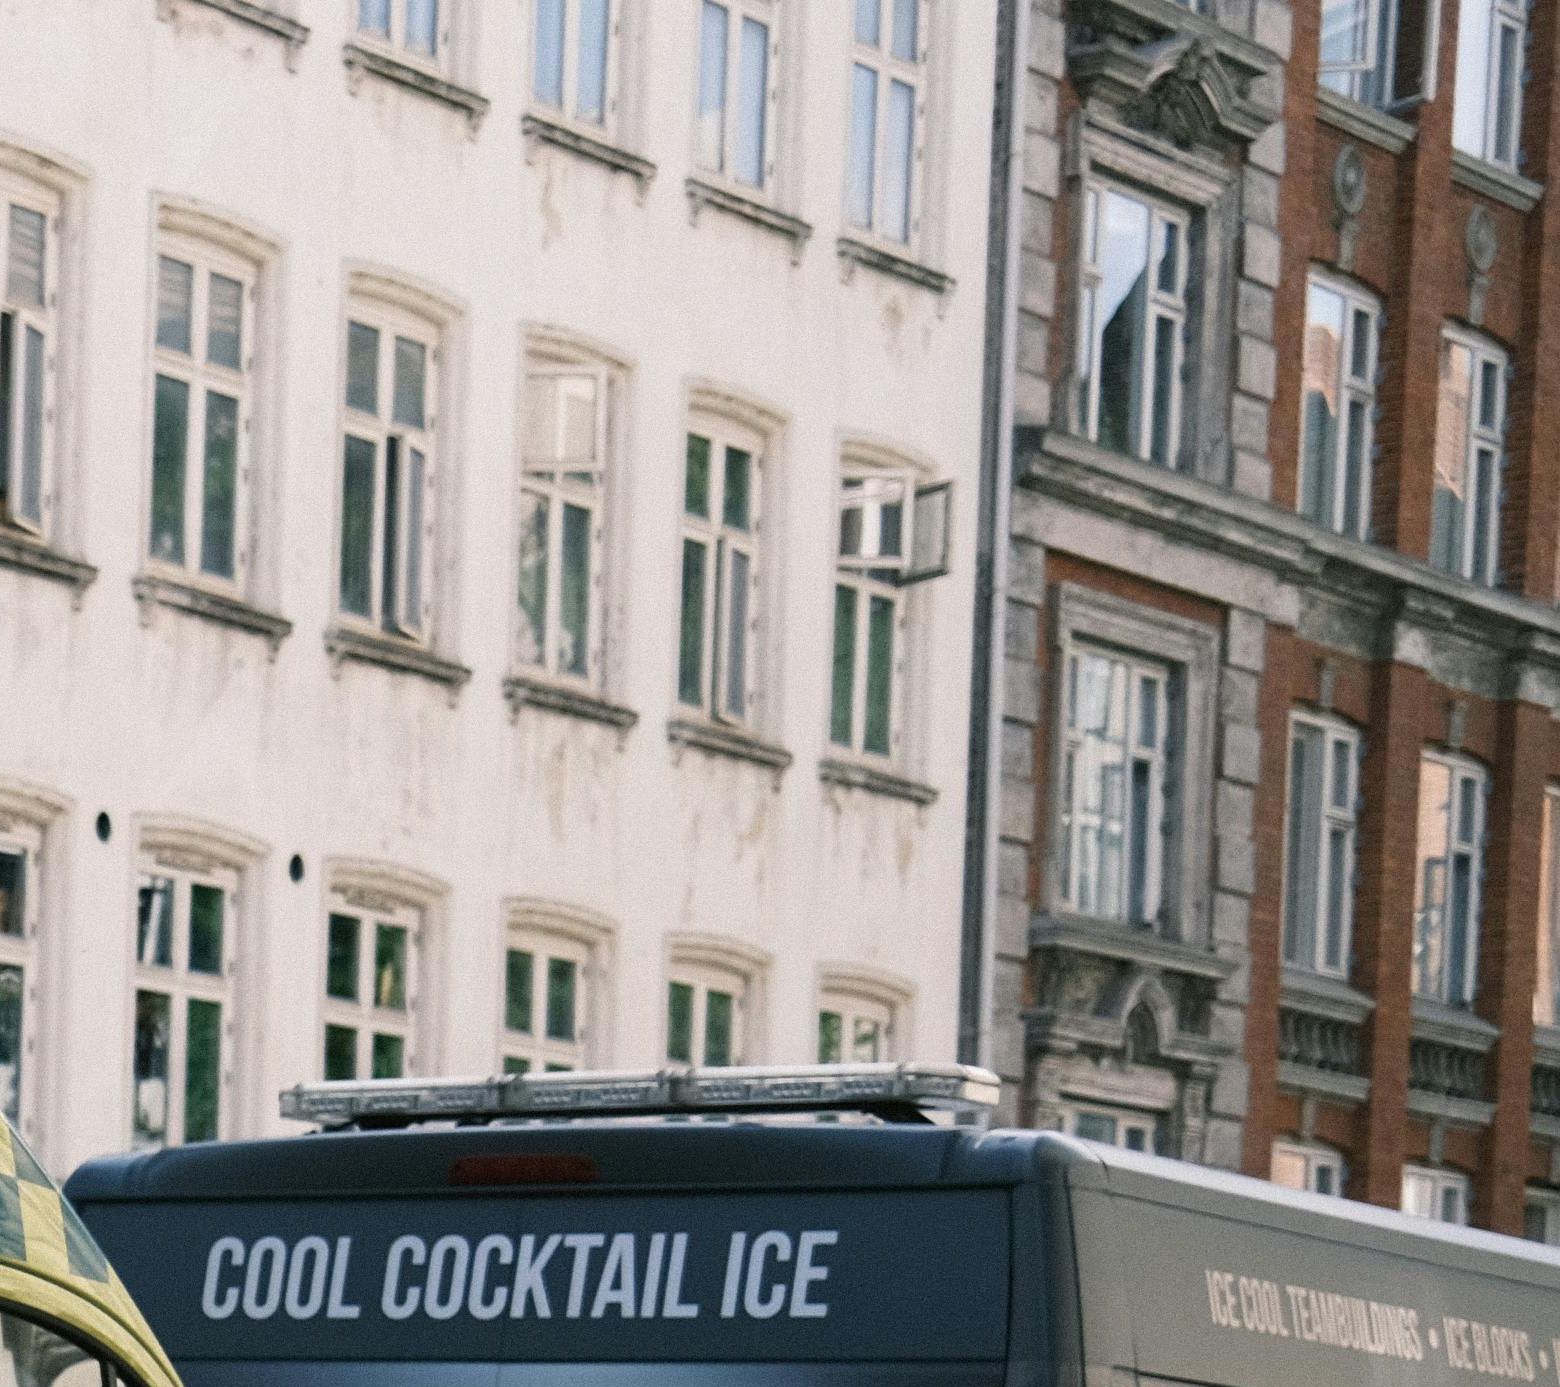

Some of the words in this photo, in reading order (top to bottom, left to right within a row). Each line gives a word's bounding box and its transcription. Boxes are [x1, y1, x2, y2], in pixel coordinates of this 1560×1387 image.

[201, 1235, 361, 1320] COOL
[381, 1231, 699, 1320] COCKTAIL
[720, 1230, 839, 1319] ICE
[1239, 1275, 1289, 1337] COOL
